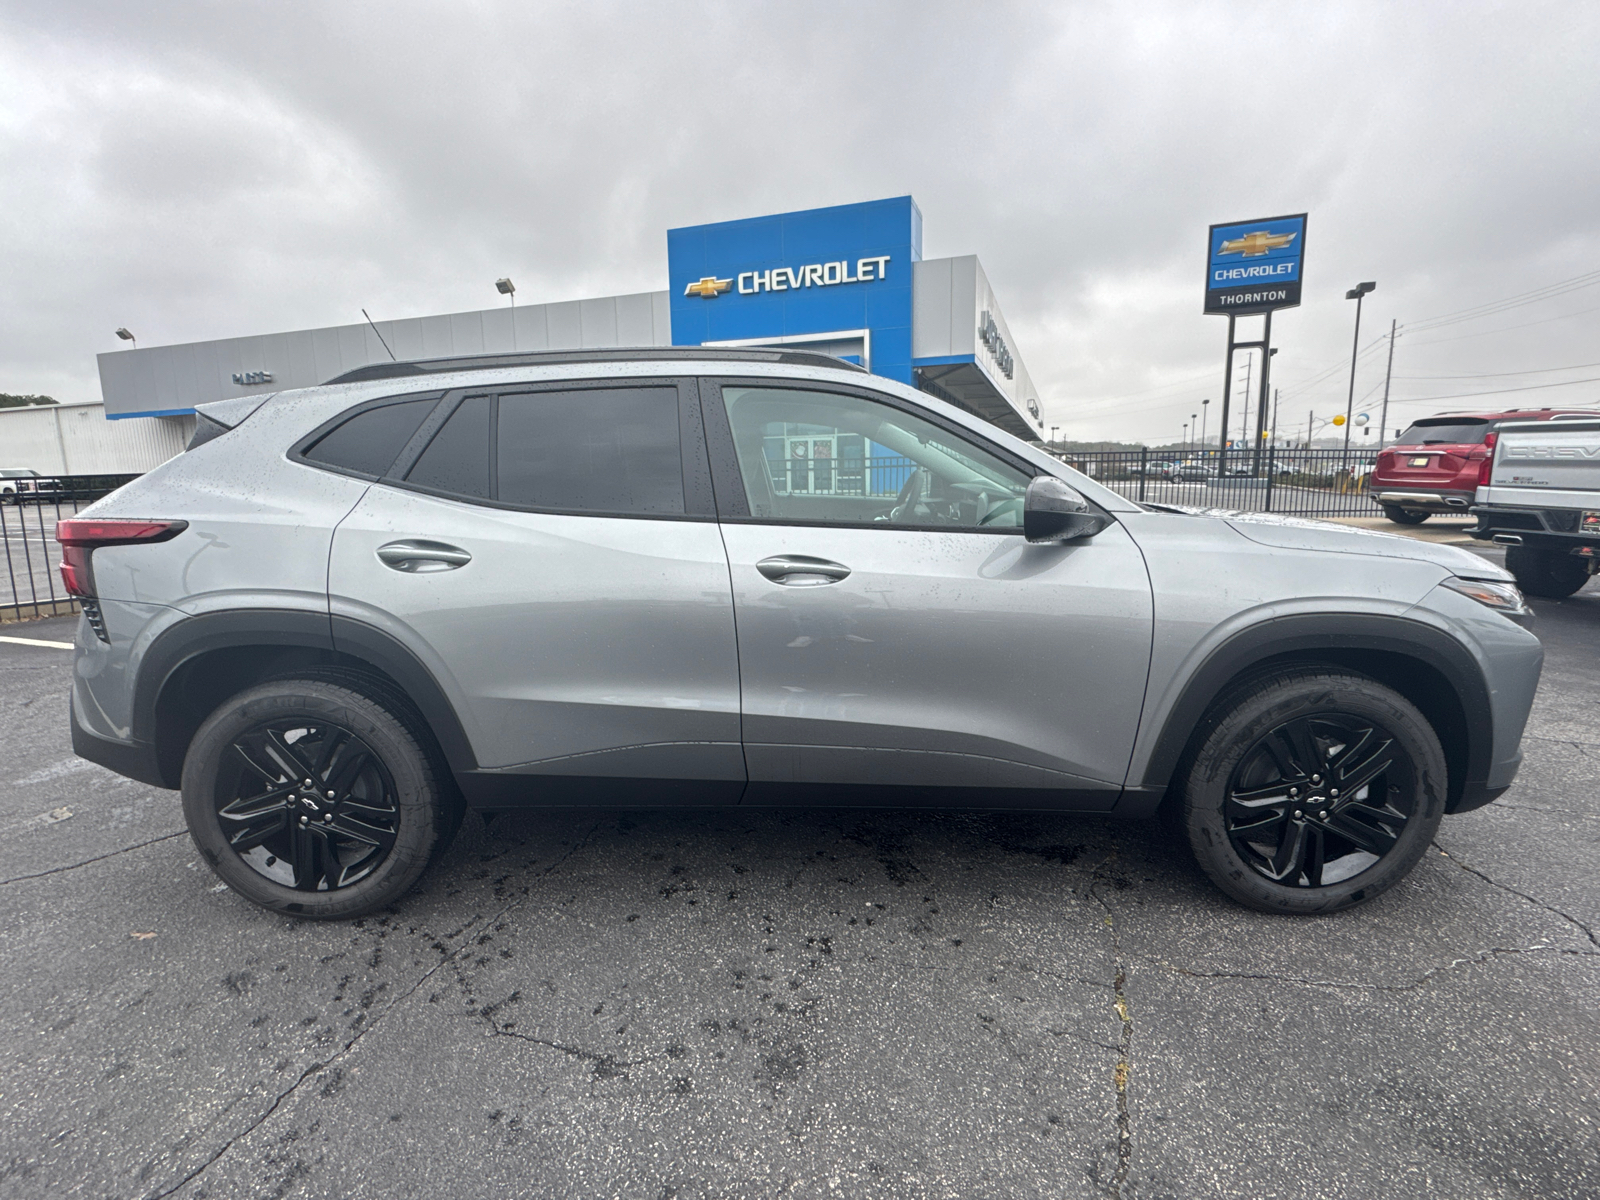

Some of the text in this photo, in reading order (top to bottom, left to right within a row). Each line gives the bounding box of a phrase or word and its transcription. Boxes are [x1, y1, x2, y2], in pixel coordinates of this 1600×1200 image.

[737, 255, 891, 295] CHEVROLET
[1214, 262, 1295, 281] CHEVROLET
[1219, 290, 1287, 305] THORNTON
